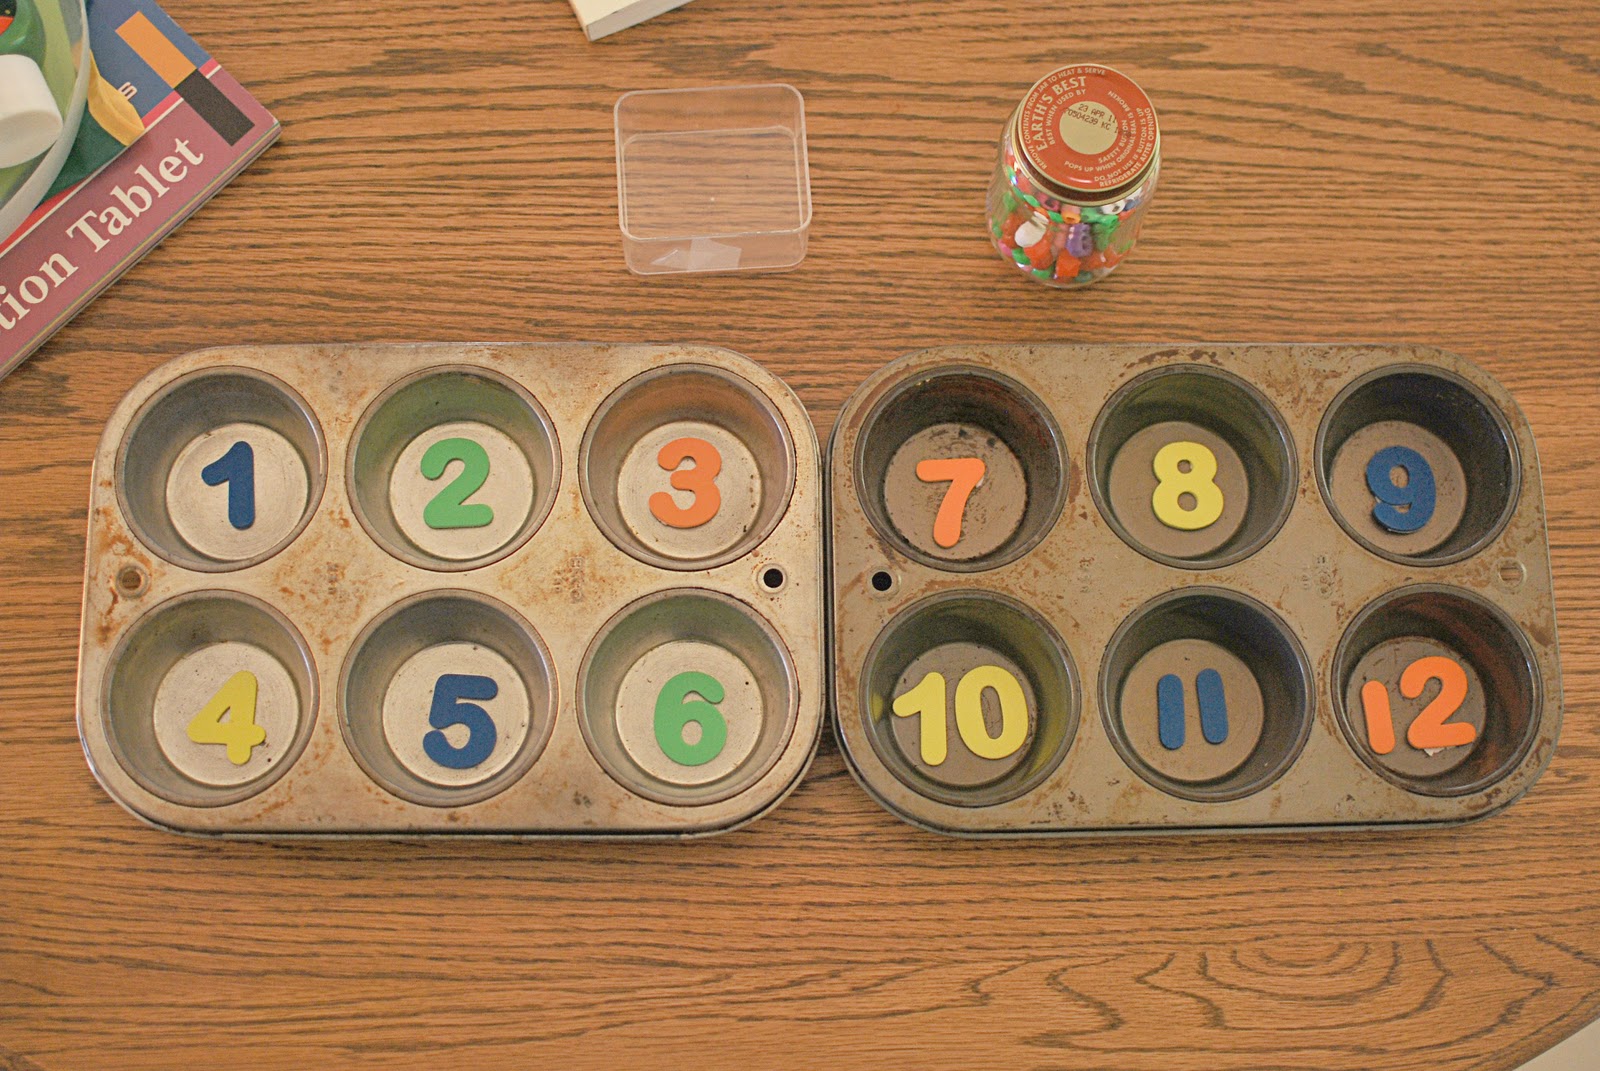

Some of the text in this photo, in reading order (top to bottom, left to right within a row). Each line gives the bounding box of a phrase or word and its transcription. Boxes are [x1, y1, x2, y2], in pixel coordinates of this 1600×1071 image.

[1047, 75, 1057, 83] TO
[1058, 69, 1075, 78] HEAT
[1085, 67, 1105, 75] SERVE
[1026, 91, 1039, 109] FROM
[1037, 81, 1049, 93] JAR
[1056, 91, 1074, 105] USED
[1031, 76, 1086, 151] EARTH'S BEST
[1078, 103, 1088, 112] 23
[1091, 108, 1105, 118] APR
[1107, 90, 1130, 112] BROKEN
[1136, 107, 1144, 117] UP
[1023, 110, 1031, 144] CONTENTS
[1046, 104, 1058, 126] WHEN
[1046, 128, 1055, 145] BEST
[1099, 107, 1154, 187] REFRIGERATE AFTER OPENING
[1116, 136, 1136, 162] ORIGINAL
[1136, 127, 1146, 153] BUTTON
[1028, 145, 1047, 169] REMOVE
[1064, 161, 1082, 171] POPS
[1096, 161, 1116, 171] WHEN
[1098, 147, 1120, 163] SAFETY
[1122, 160, 1134, 170] USE
[1107, 169, 1121, 179] NOT
[65, 138, 204, 253] Tablet
[202, 443, 253, 527] 1
[421, 439, 492, 527] 2
[649, 438, 722, 528] 3
[1153, 441, 1223, 529] 8
[1365, 446, 1436, 532] 9
[916, 457, 987, 547] 7
[187, 671, 266, 764] 4
[894, 665, 1028, 765] 10
[1156, 669, 1228, 750] 11
[1362, 656, 1477, 754] 12
[424, 676, 496, 767] 5
[654, 673, 726, 765] 6
